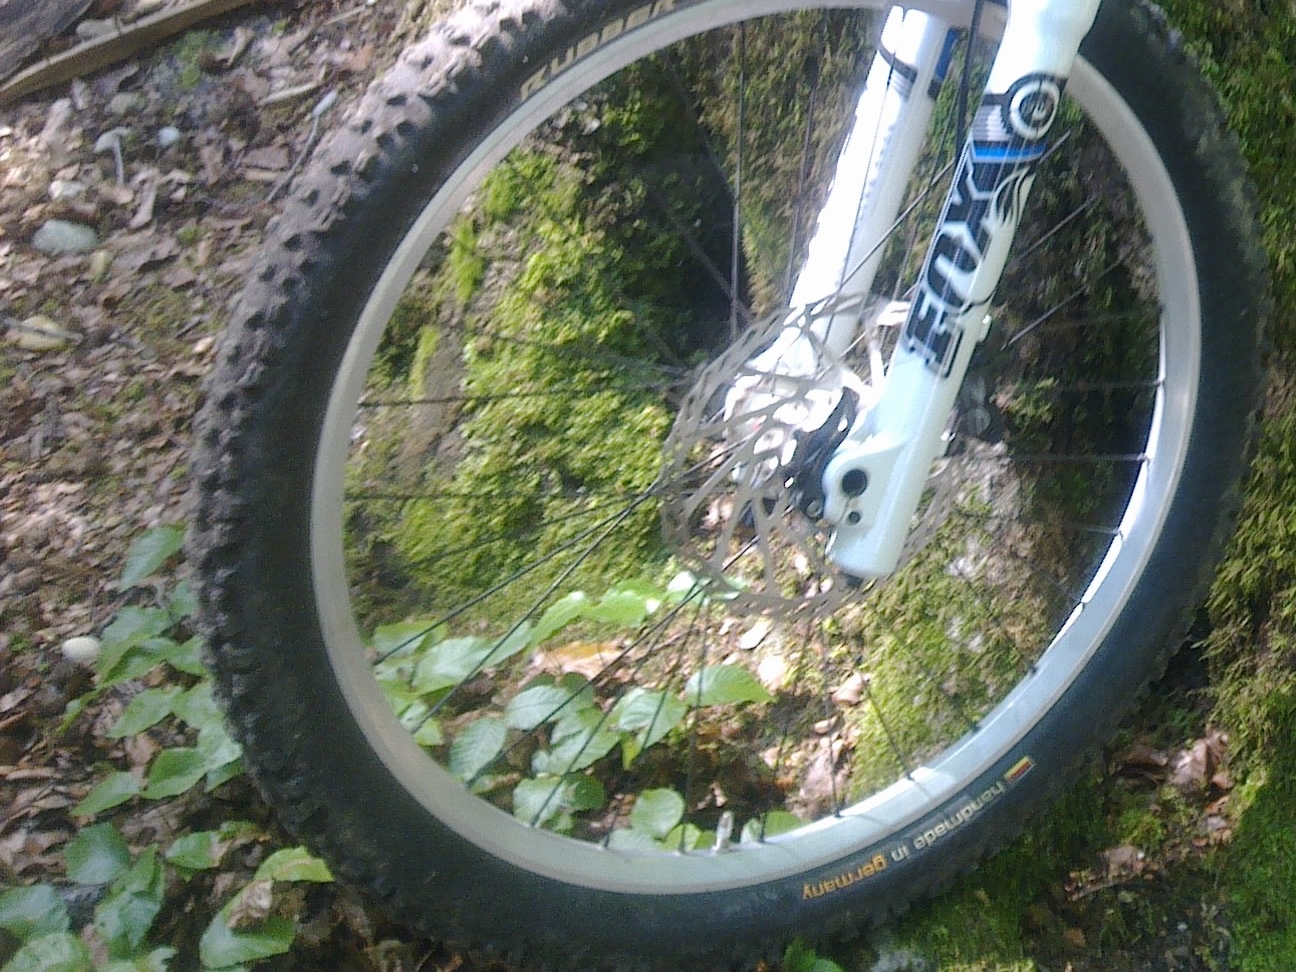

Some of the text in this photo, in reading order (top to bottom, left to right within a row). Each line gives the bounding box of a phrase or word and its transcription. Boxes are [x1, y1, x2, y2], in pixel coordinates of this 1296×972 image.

[905, 158, 1024, 378] FOX
[802, 781, 1007, 901] handmade in germany
